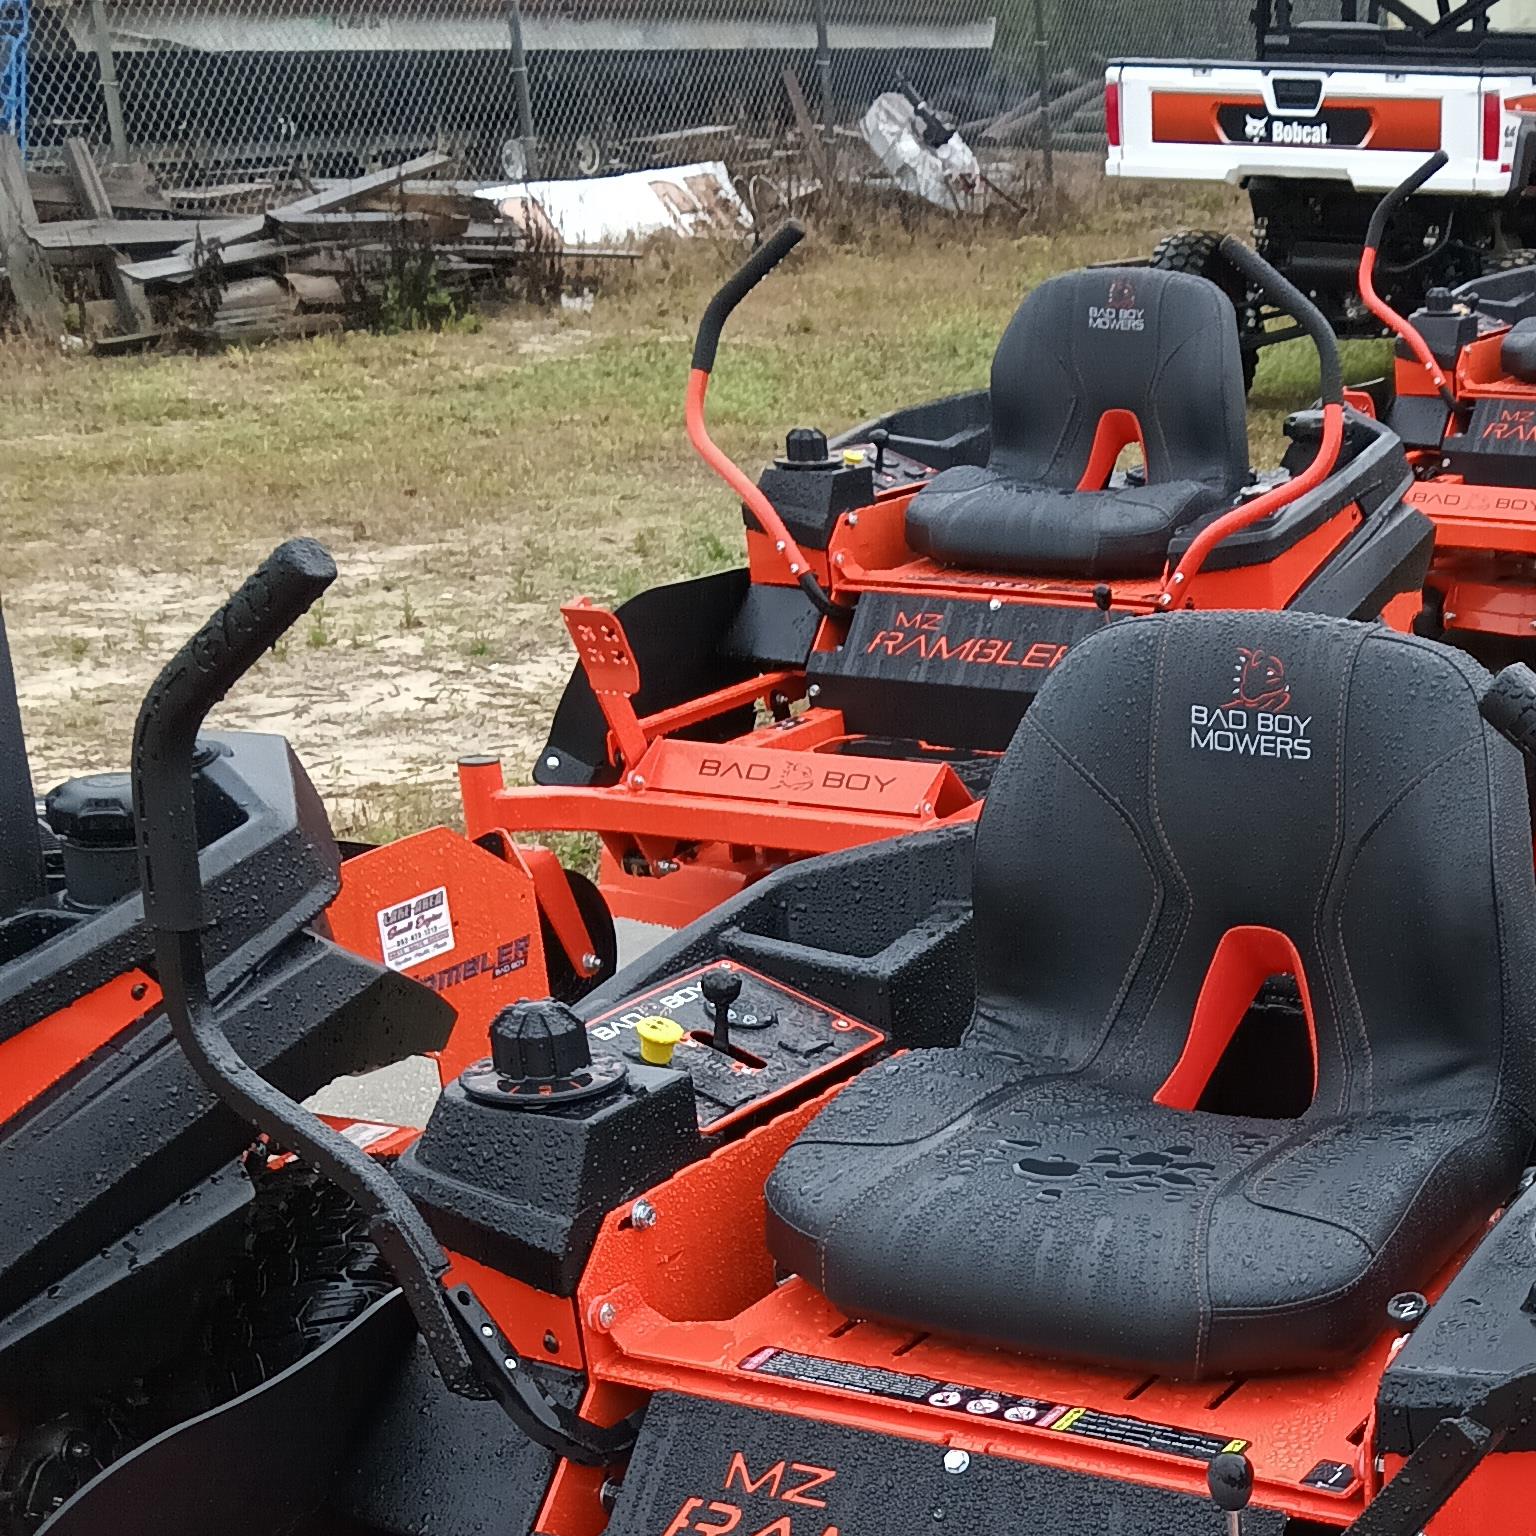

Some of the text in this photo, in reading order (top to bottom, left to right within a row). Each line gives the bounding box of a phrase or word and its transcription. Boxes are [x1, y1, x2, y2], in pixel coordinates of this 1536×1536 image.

[1272, 121, 1328, 144] Bobcat
[1501, 410, 1536, 423] MZ
[1412, 493, 1461, 506] BAD
[895, 611, 944, 630] MZ
[1191, 704, 1312, 737] BAD BOY
[1190, 727, 1312, 760] MOWERS
[698, 759, 897, 792] BAD BOY
[725, 1451, 836, 1508] MZ
